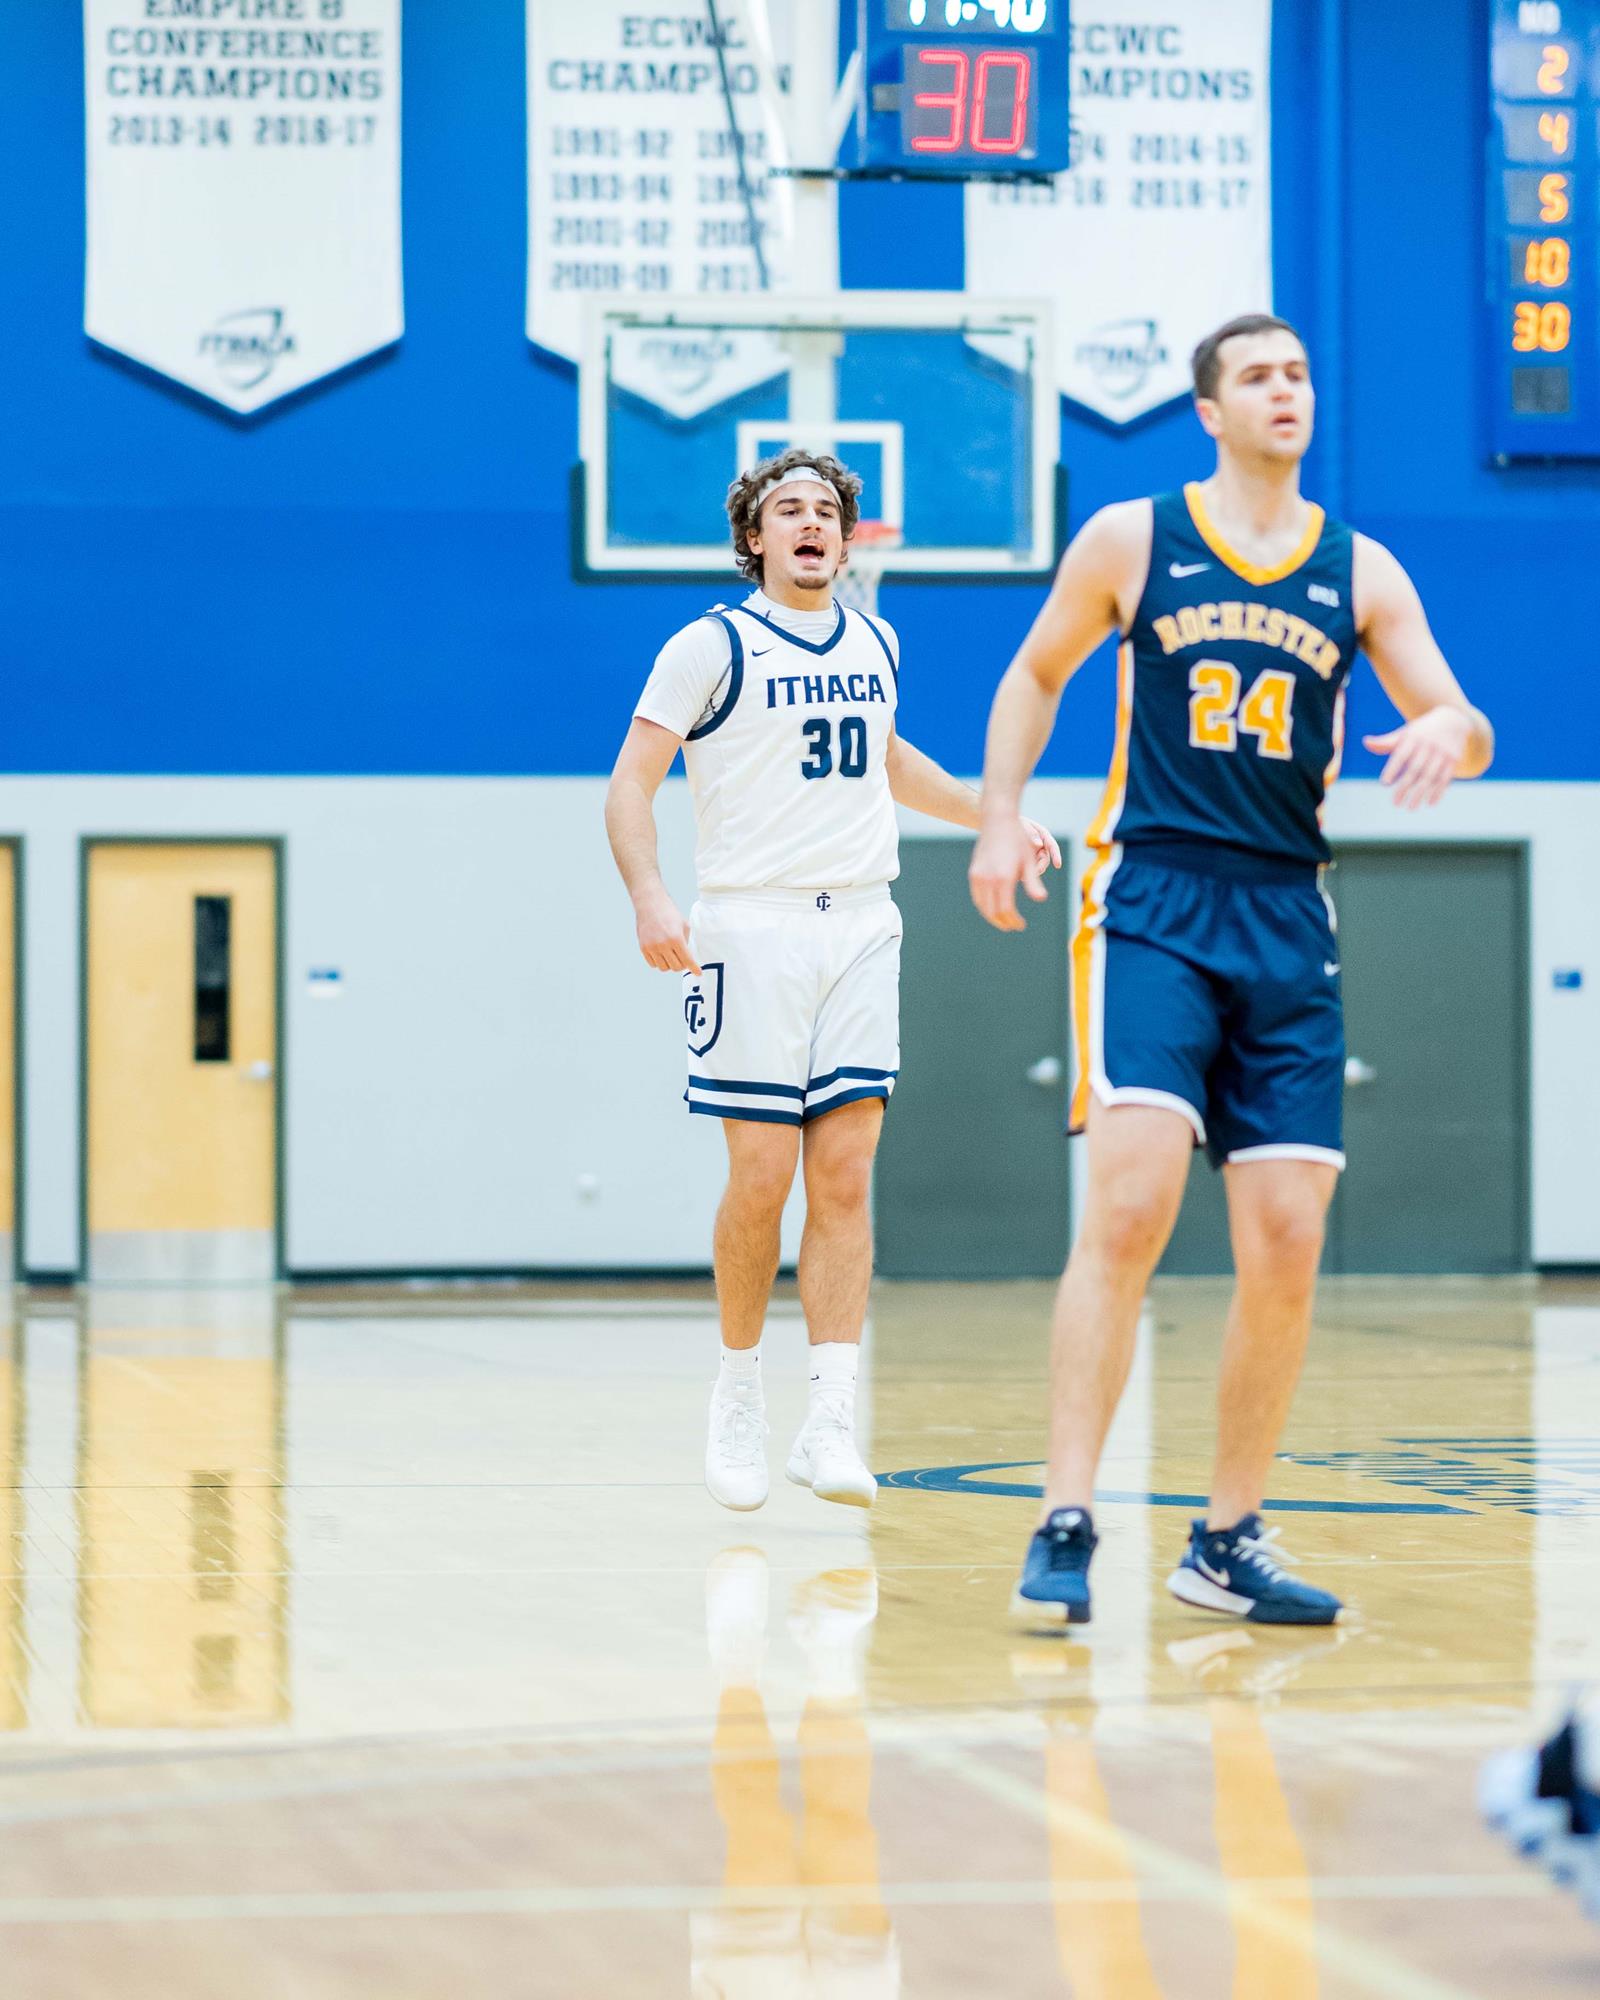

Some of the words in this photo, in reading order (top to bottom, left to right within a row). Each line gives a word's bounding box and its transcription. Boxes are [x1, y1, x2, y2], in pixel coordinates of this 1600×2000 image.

[144, 0, 304, 19] EMPIRE
[106, 26, 382, 58] CONFERENCE
[1070, 24, 1181, 55] CWC
[106, 64, 383, 100] CHAMPIONS
[1537, 45, 1569, 94] 2
[911, 50, 1031, 153] 30
[1538, 112, 1569, 155] 4
[1538, 173, 1569, 223] 5
[1524, 237, 1570, 287] 10
[1512, 301, 1571, 352] 30
[1152, 601, 1341, 681] ROCHESTER
[767, 674, 887, 709] ITHACA
[1188, 658, 1297, 762] 24
[801, 716, 868, 780] 30
